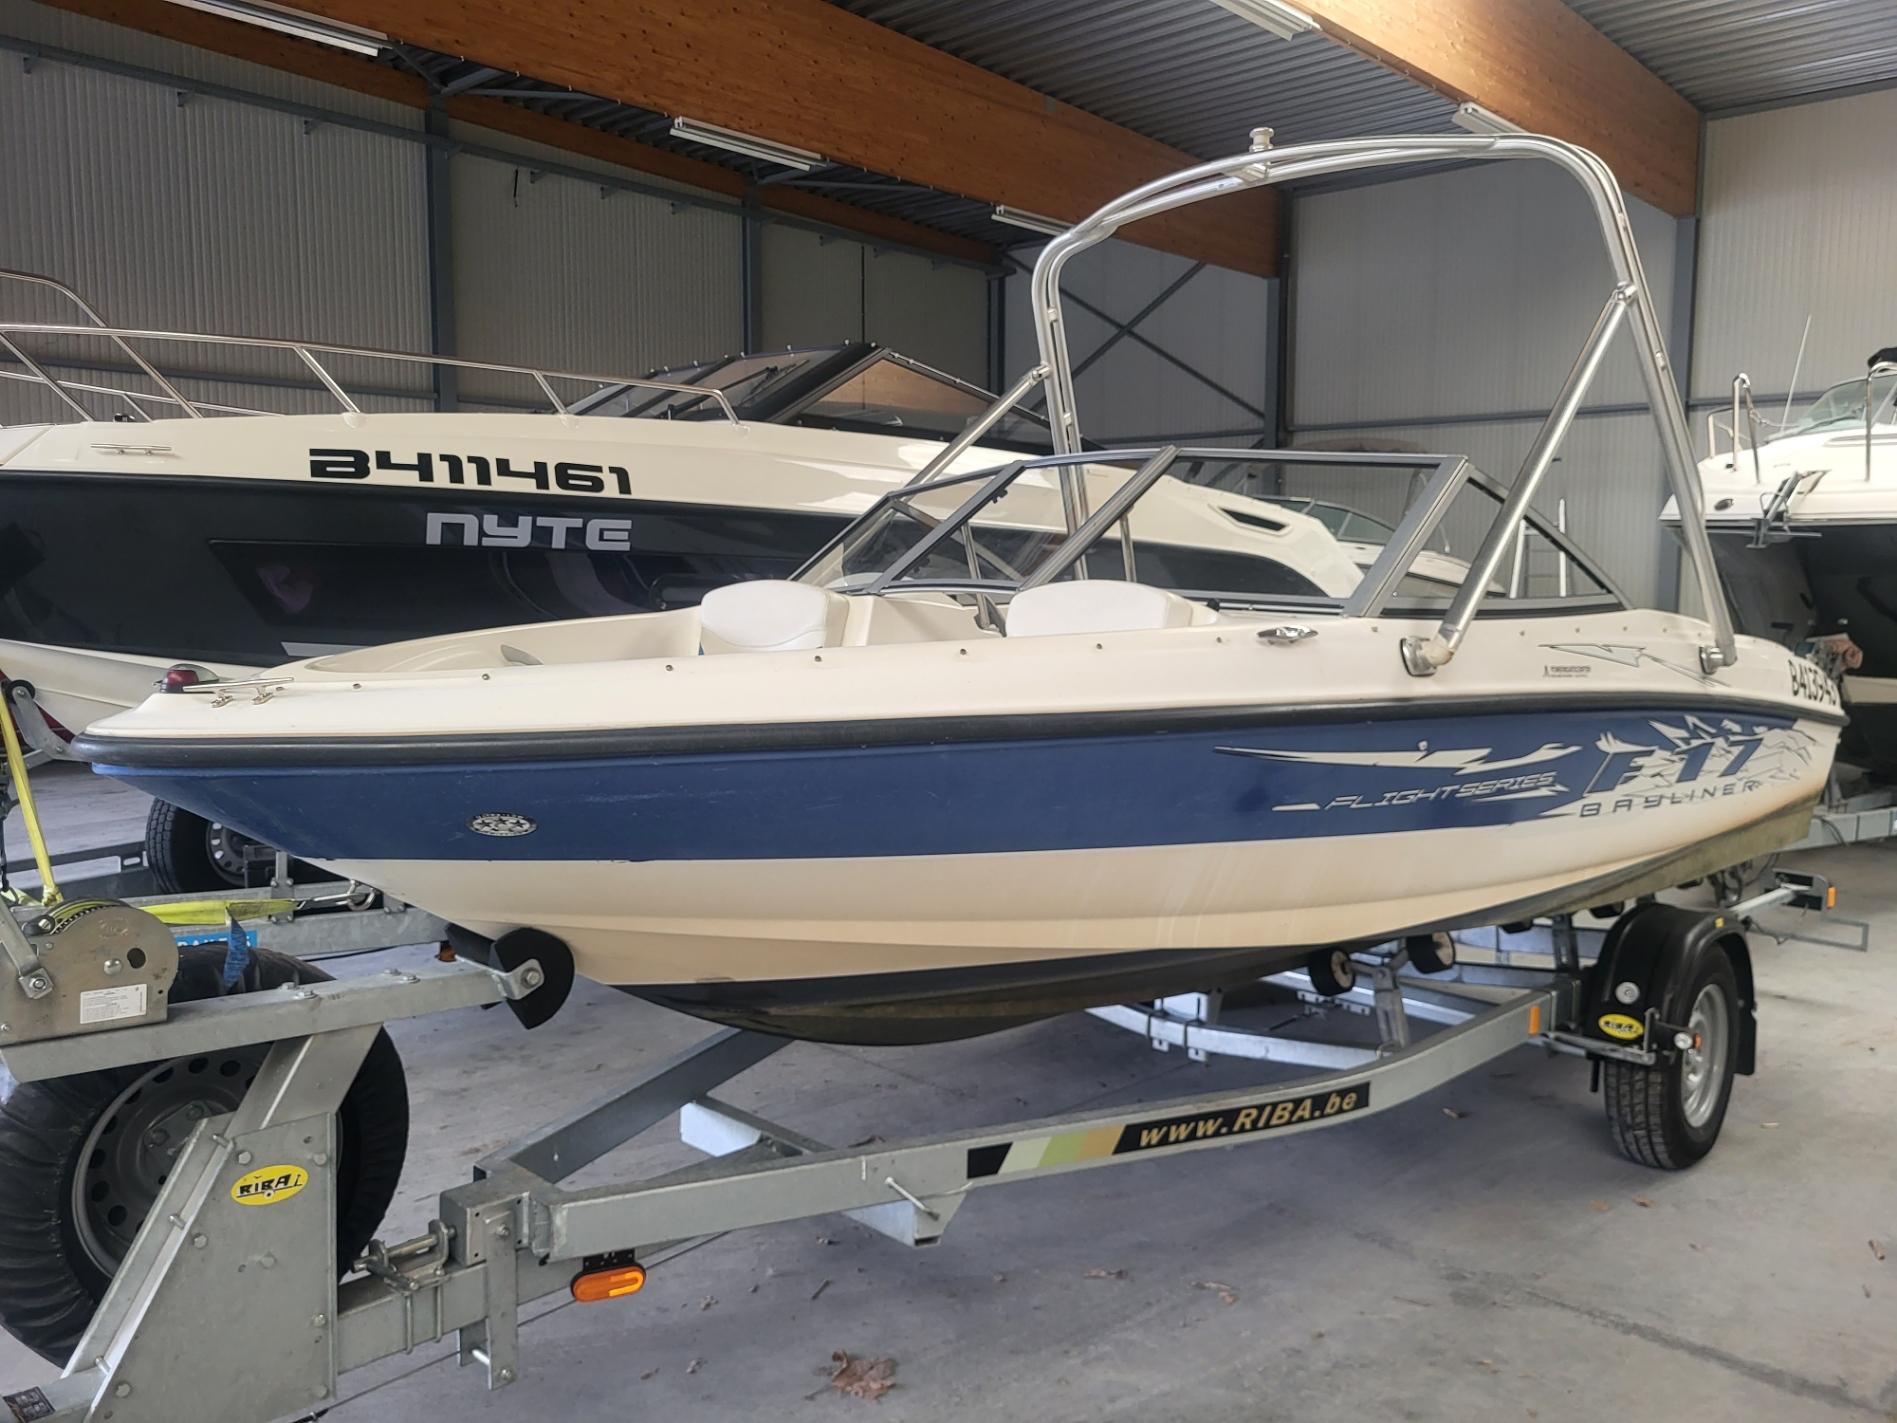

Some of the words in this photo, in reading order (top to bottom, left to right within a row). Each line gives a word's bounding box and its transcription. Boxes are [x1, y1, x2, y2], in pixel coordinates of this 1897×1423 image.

[309, 448, 632, 495] B411461
[426, 512, 632, 551] NYTE
[1580, 780, 1758, 817] BAYLINER
[1139, 1091, 1358, 1147] www.RIBA.be
[239, 1174, 292, 1195] RIBA
